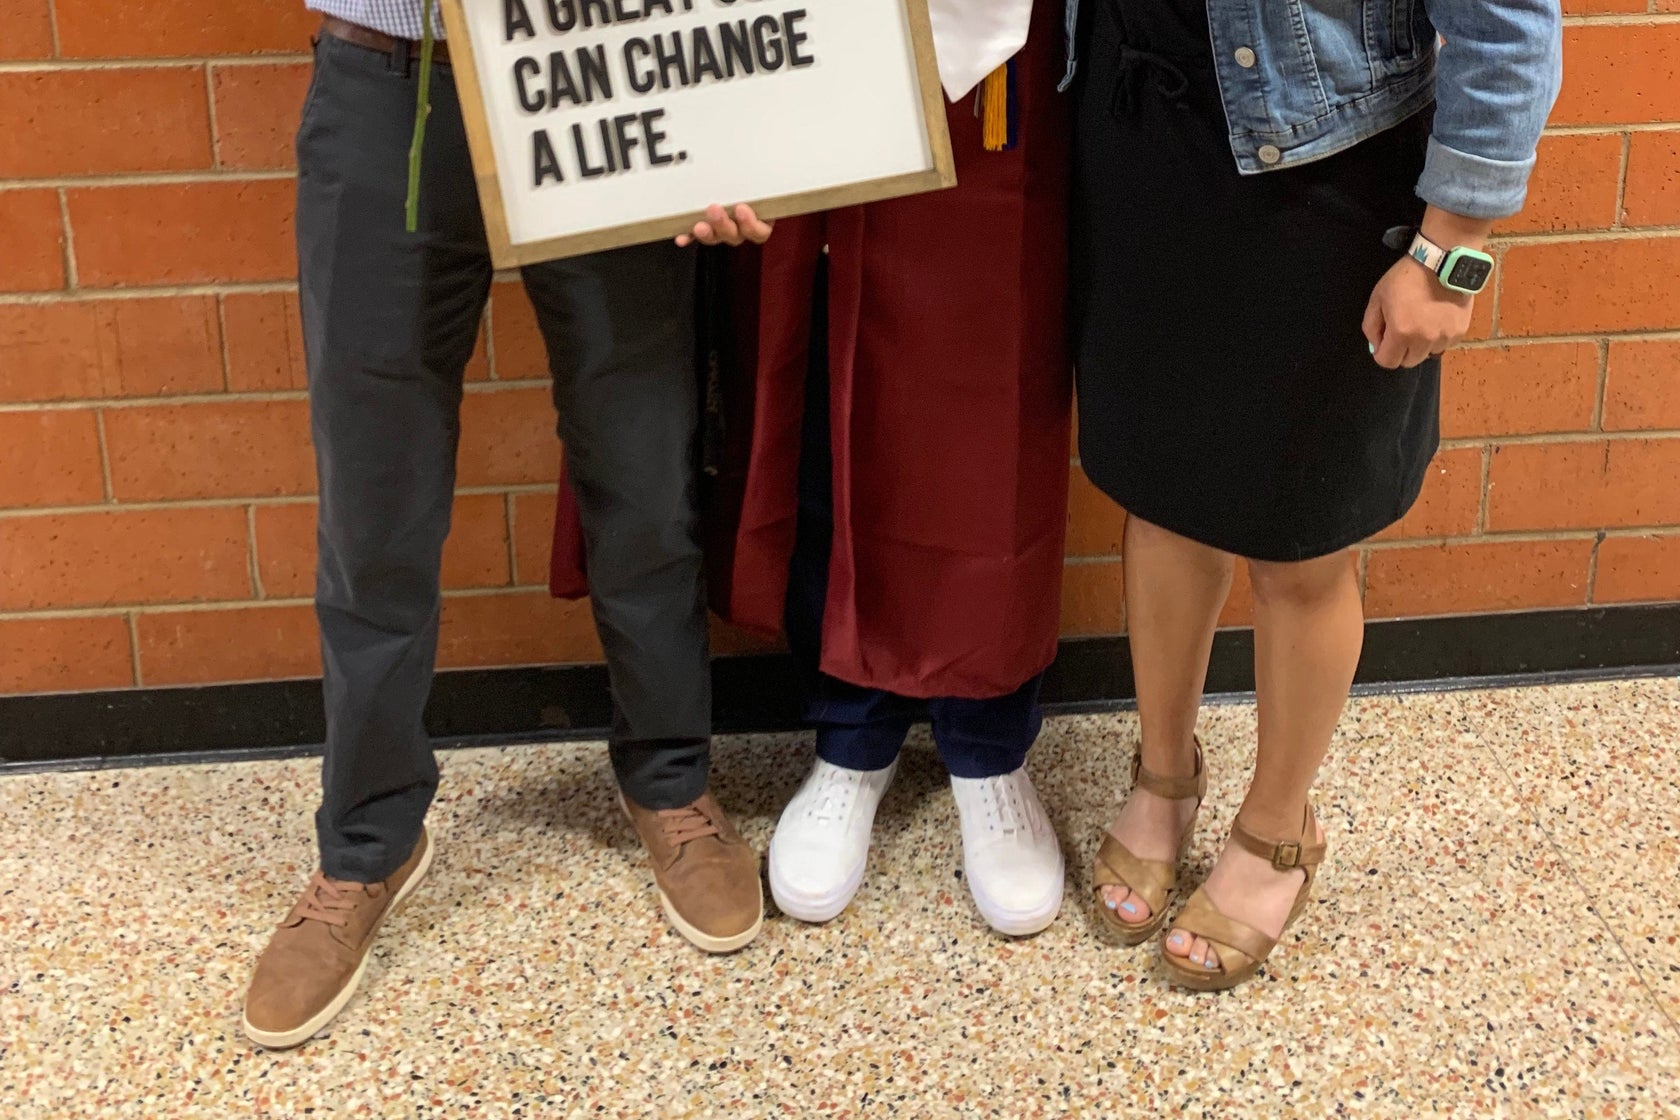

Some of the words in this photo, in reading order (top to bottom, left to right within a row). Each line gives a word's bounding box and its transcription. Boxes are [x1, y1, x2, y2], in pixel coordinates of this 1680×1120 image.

[513, 44, 613, 113] CAN
[623, 9, 814, 94] CHANGE
[533, 130, 564, 186] A
[572, 108, 687, 178] LIFE.
